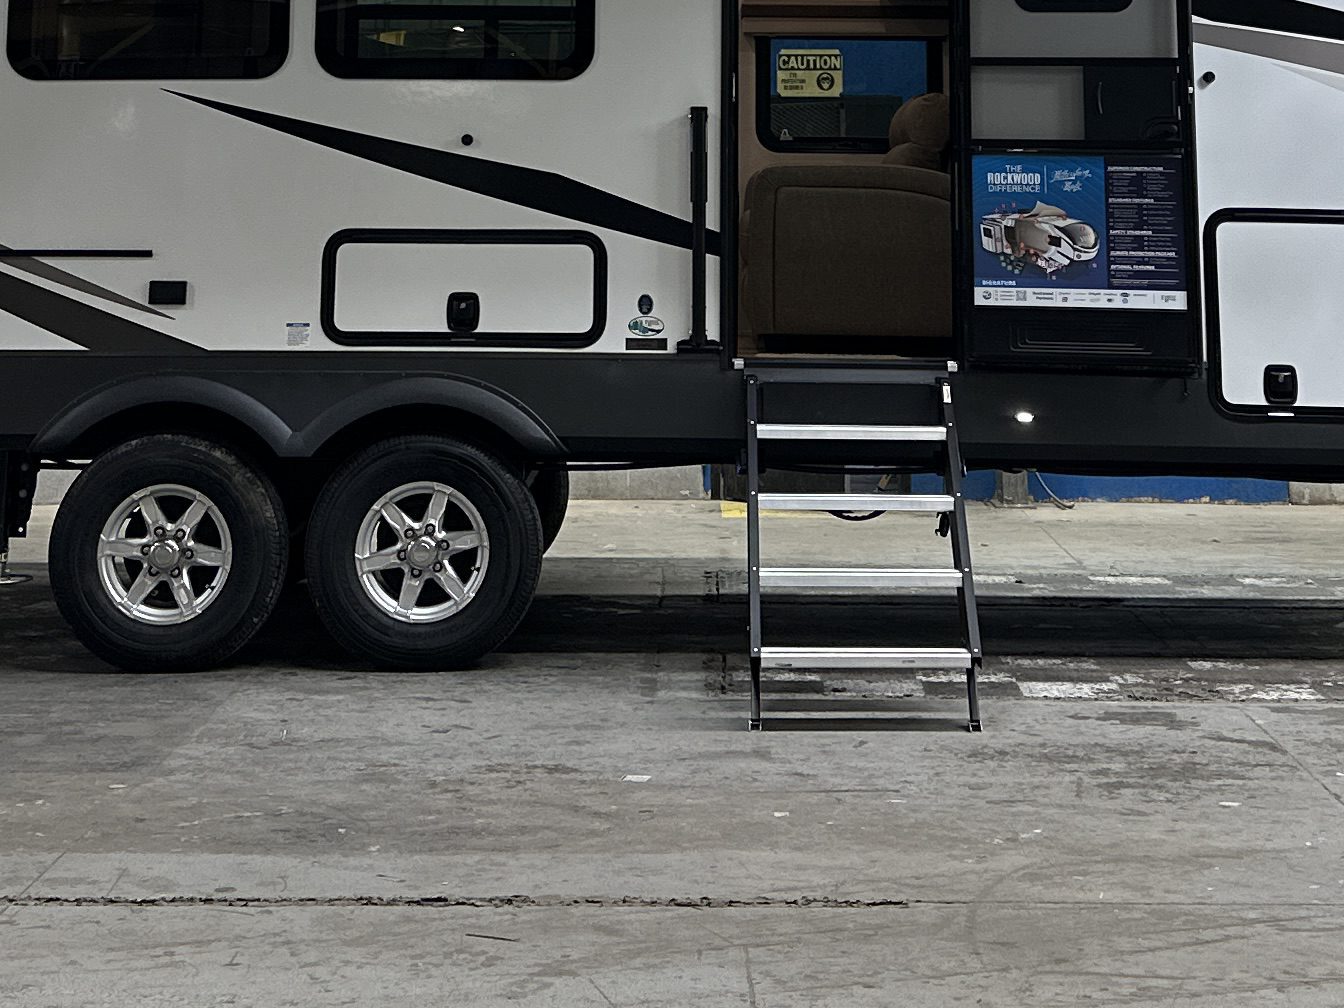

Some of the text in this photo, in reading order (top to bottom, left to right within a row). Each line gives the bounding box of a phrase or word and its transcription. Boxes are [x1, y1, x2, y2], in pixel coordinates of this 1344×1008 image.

[778, 55, 841, 70] CAUTION
[1005, 164, 1023, 173] THE
[987, 172, 1041, 185] ROCKWOOD
[988, 184, 1041, 193] DIFFERENCE
